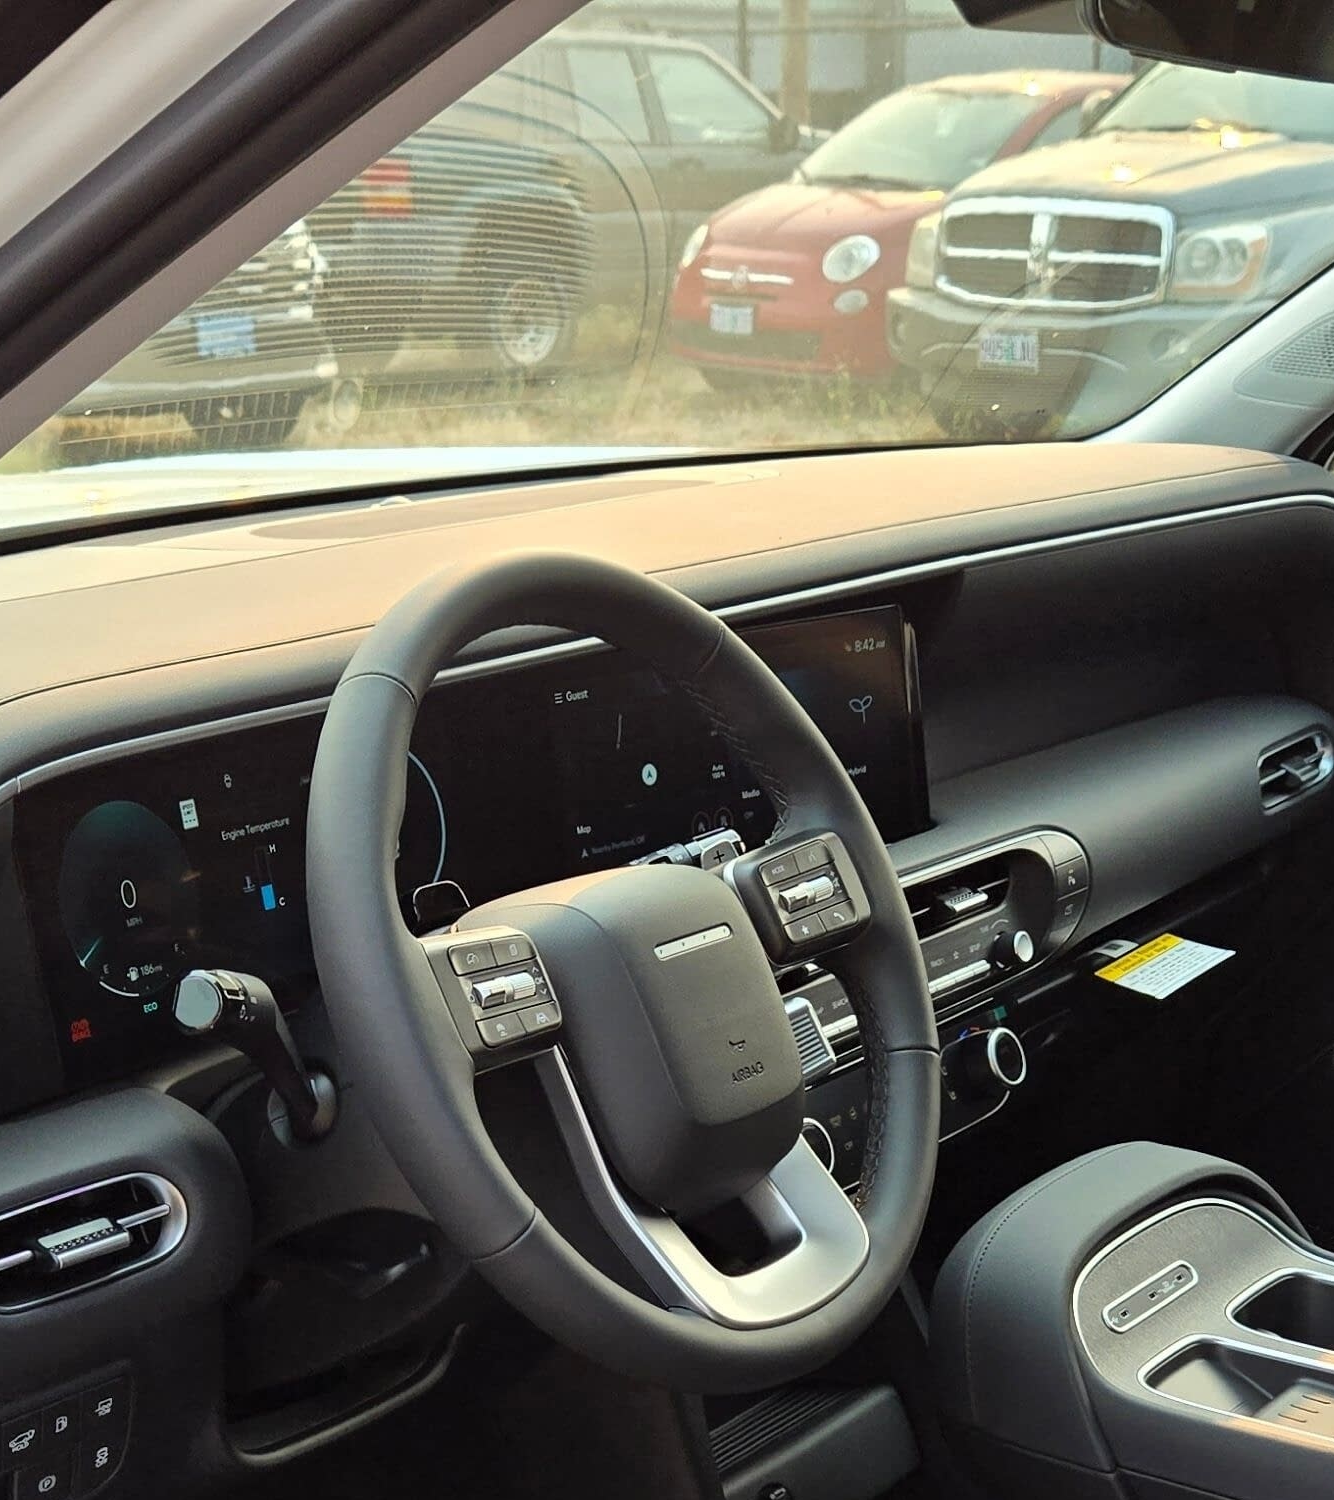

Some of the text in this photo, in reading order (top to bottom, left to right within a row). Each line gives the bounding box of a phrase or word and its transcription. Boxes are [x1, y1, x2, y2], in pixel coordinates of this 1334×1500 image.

[854, 637, 874, 652] 8:42
[566, 690, 588, 701] Guest
[221, 817, 290, 842] Engine Temperature
[577, 825, 591, 834] Map
[269, 844, 276, 853] H
[121, 879, 136, 908] 0
[279, 897, 286, 906] C
[143, 1001, 158, 1013] ECO
[731, 1061, 765, 1083] AIRBAG
